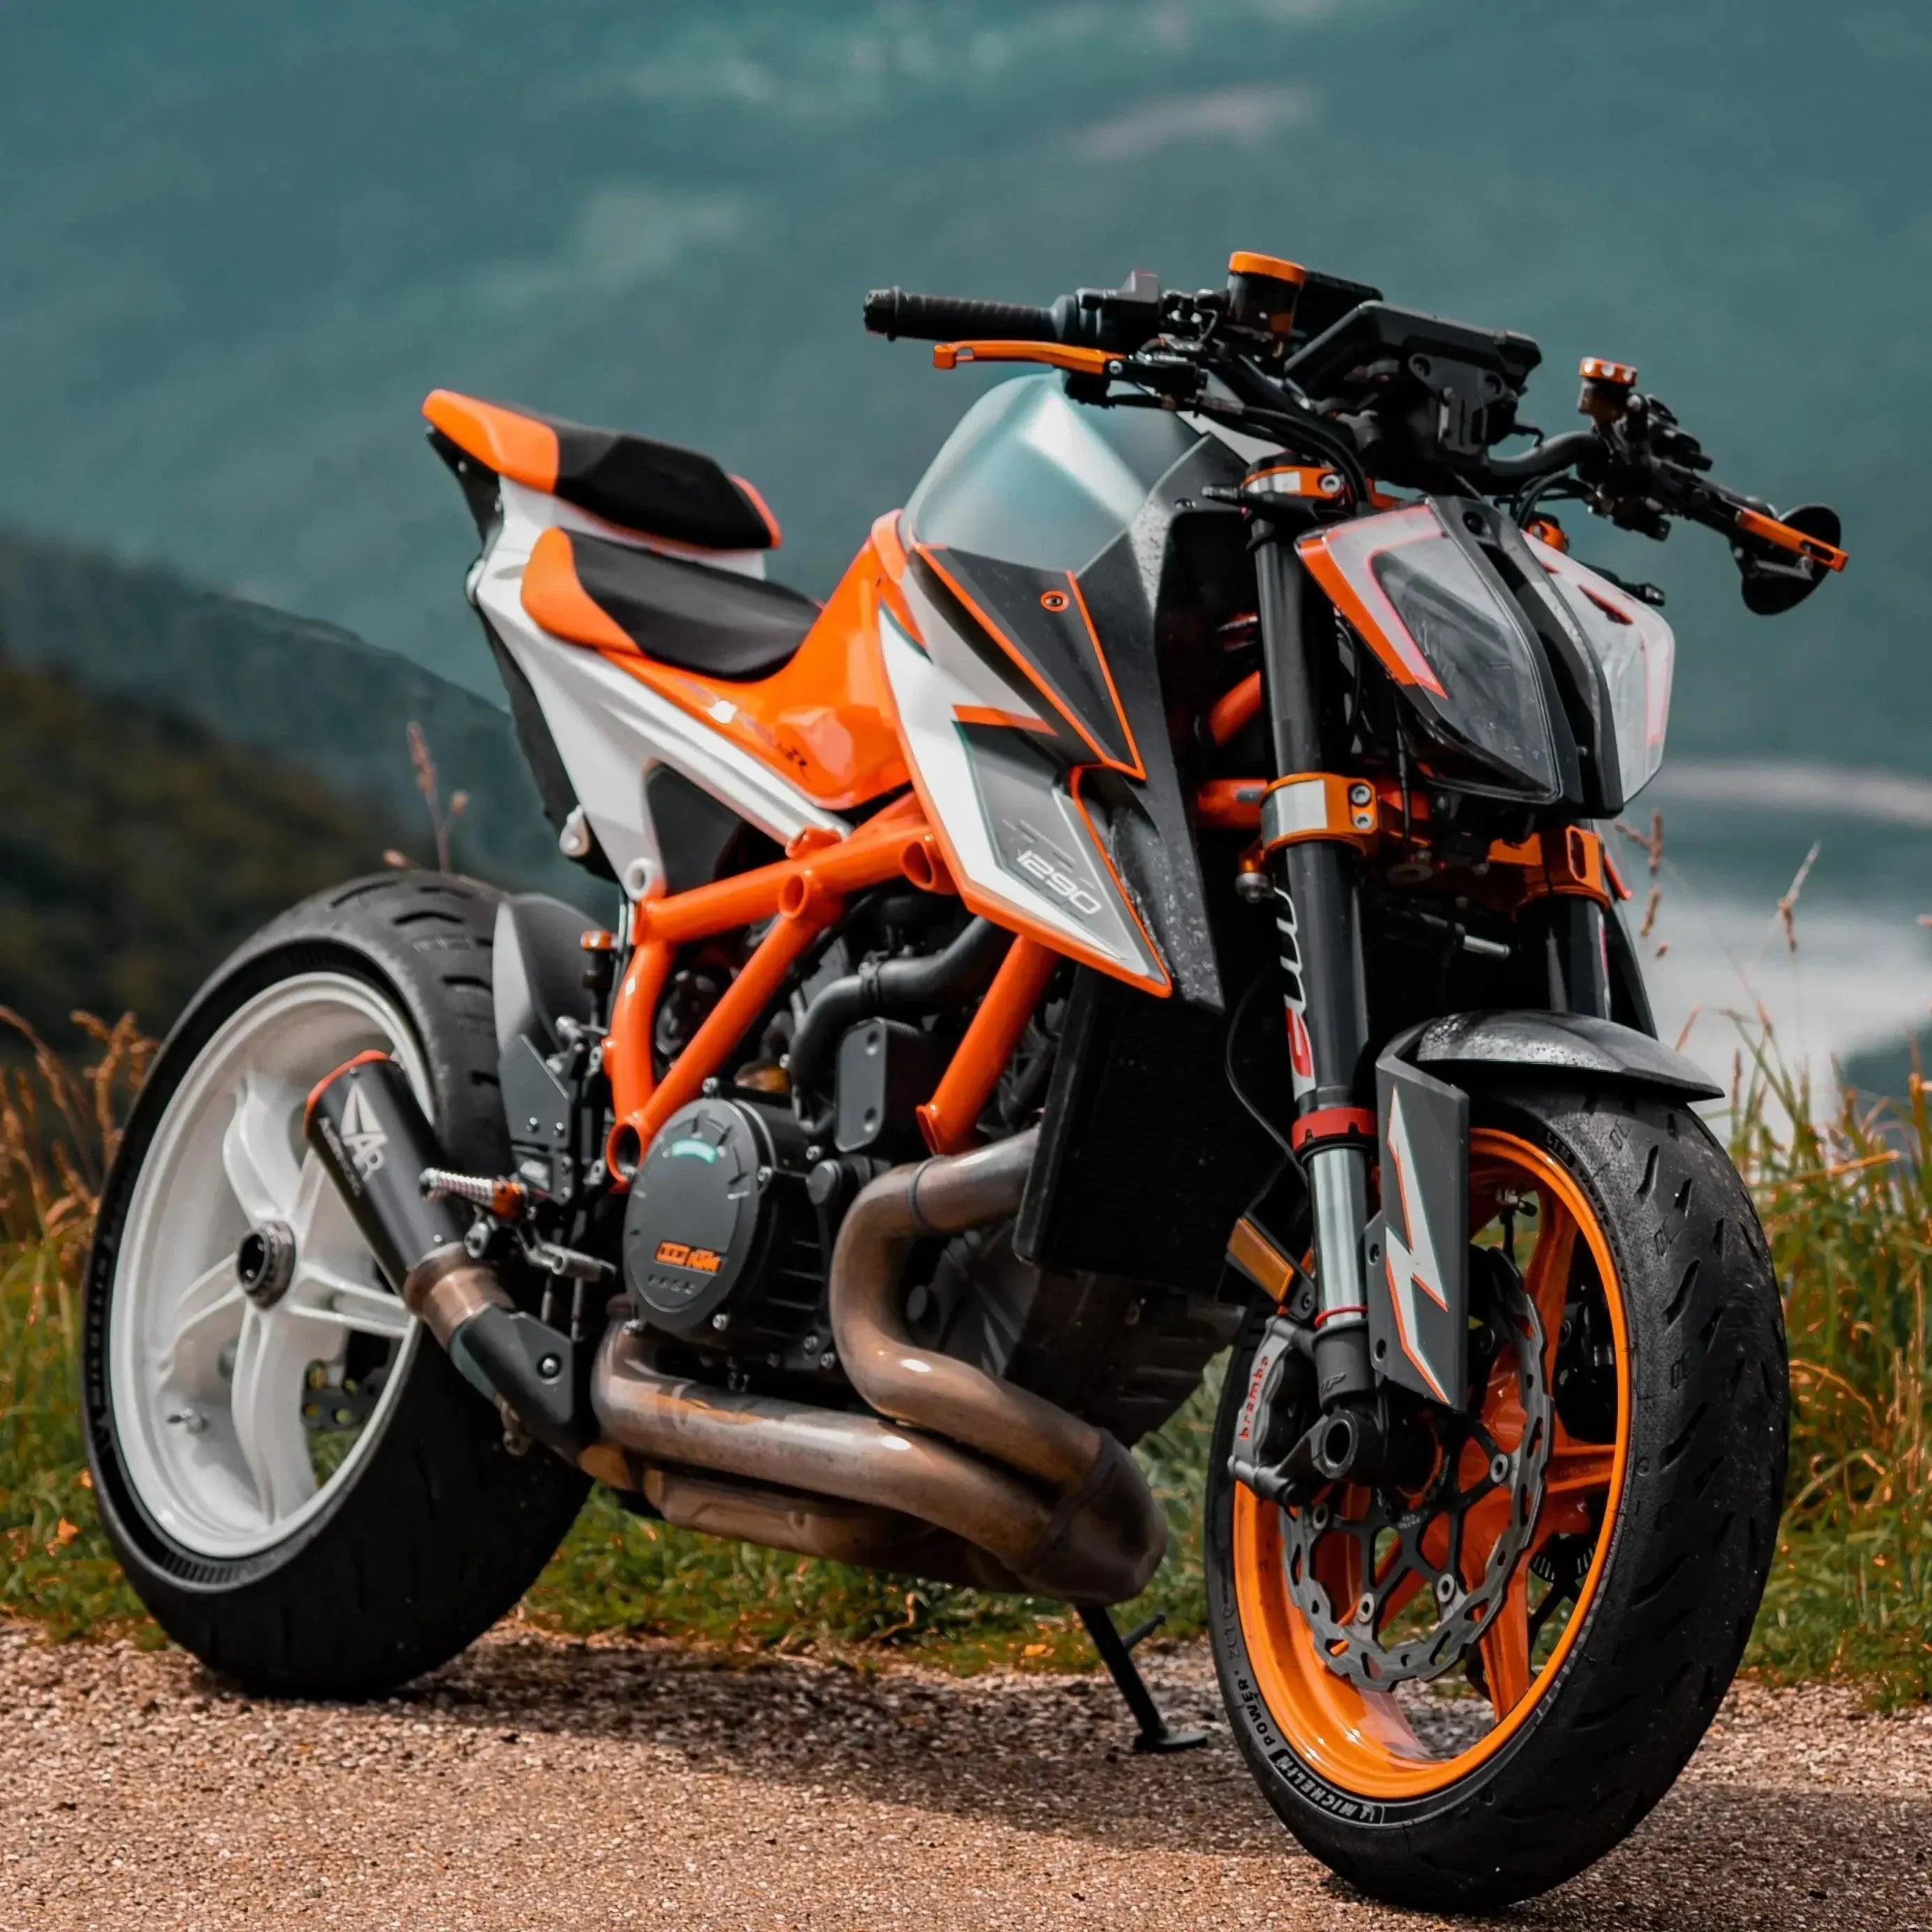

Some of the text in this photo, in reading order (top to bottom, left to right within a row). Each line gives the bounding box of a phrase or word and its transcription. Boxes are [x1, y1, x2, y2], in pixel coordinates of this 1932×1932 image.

[1017, 849, 1101, 915] 1290
[1238, 1355, 1269, 1441] brembo
[1237, 1679, 1276, 1747] POWER
[1275, 1756, 1360, 1817] MICHELIN
